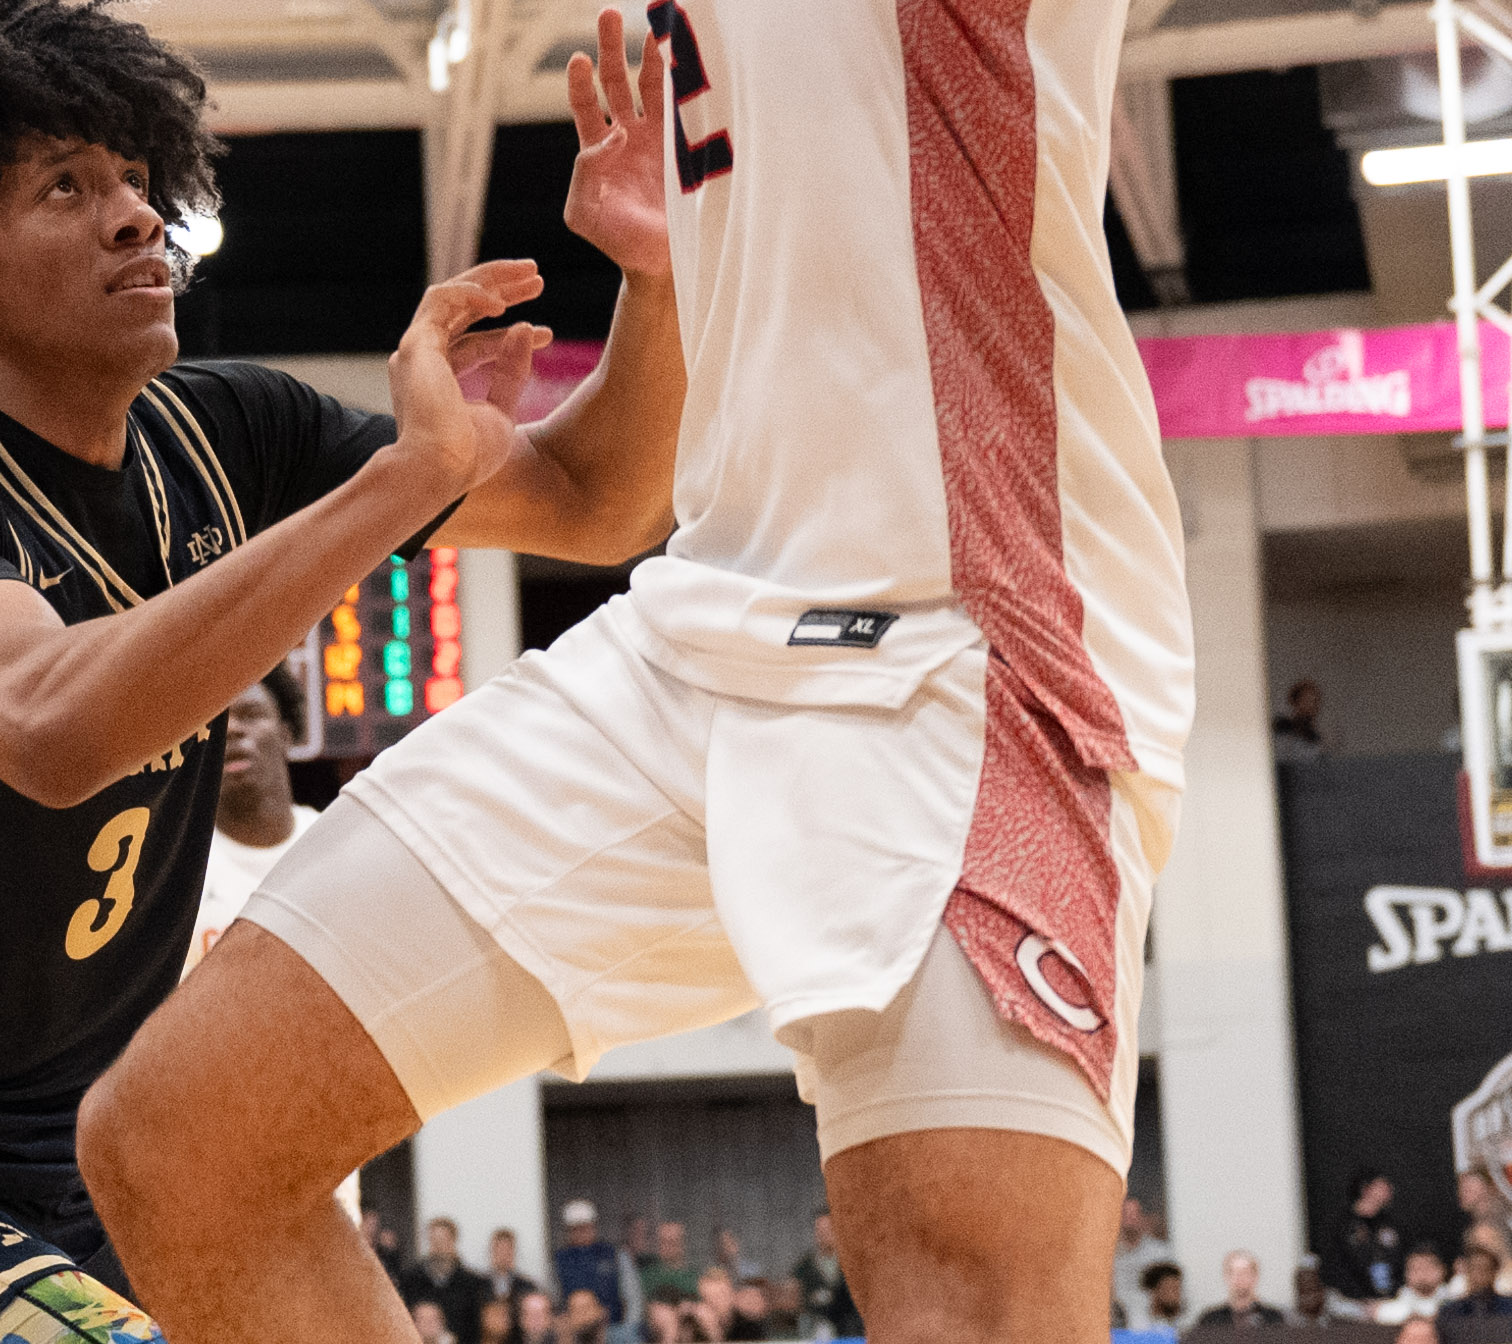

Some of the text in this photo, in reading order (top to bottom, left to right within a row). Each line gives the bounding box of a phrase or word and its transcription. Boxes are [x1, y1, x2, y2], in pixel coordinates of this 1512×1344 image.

[1244, 369, 1411, 423] SPALDING
[848, 617, 876, 634] XL
[65, 807, 150, 960] 3
